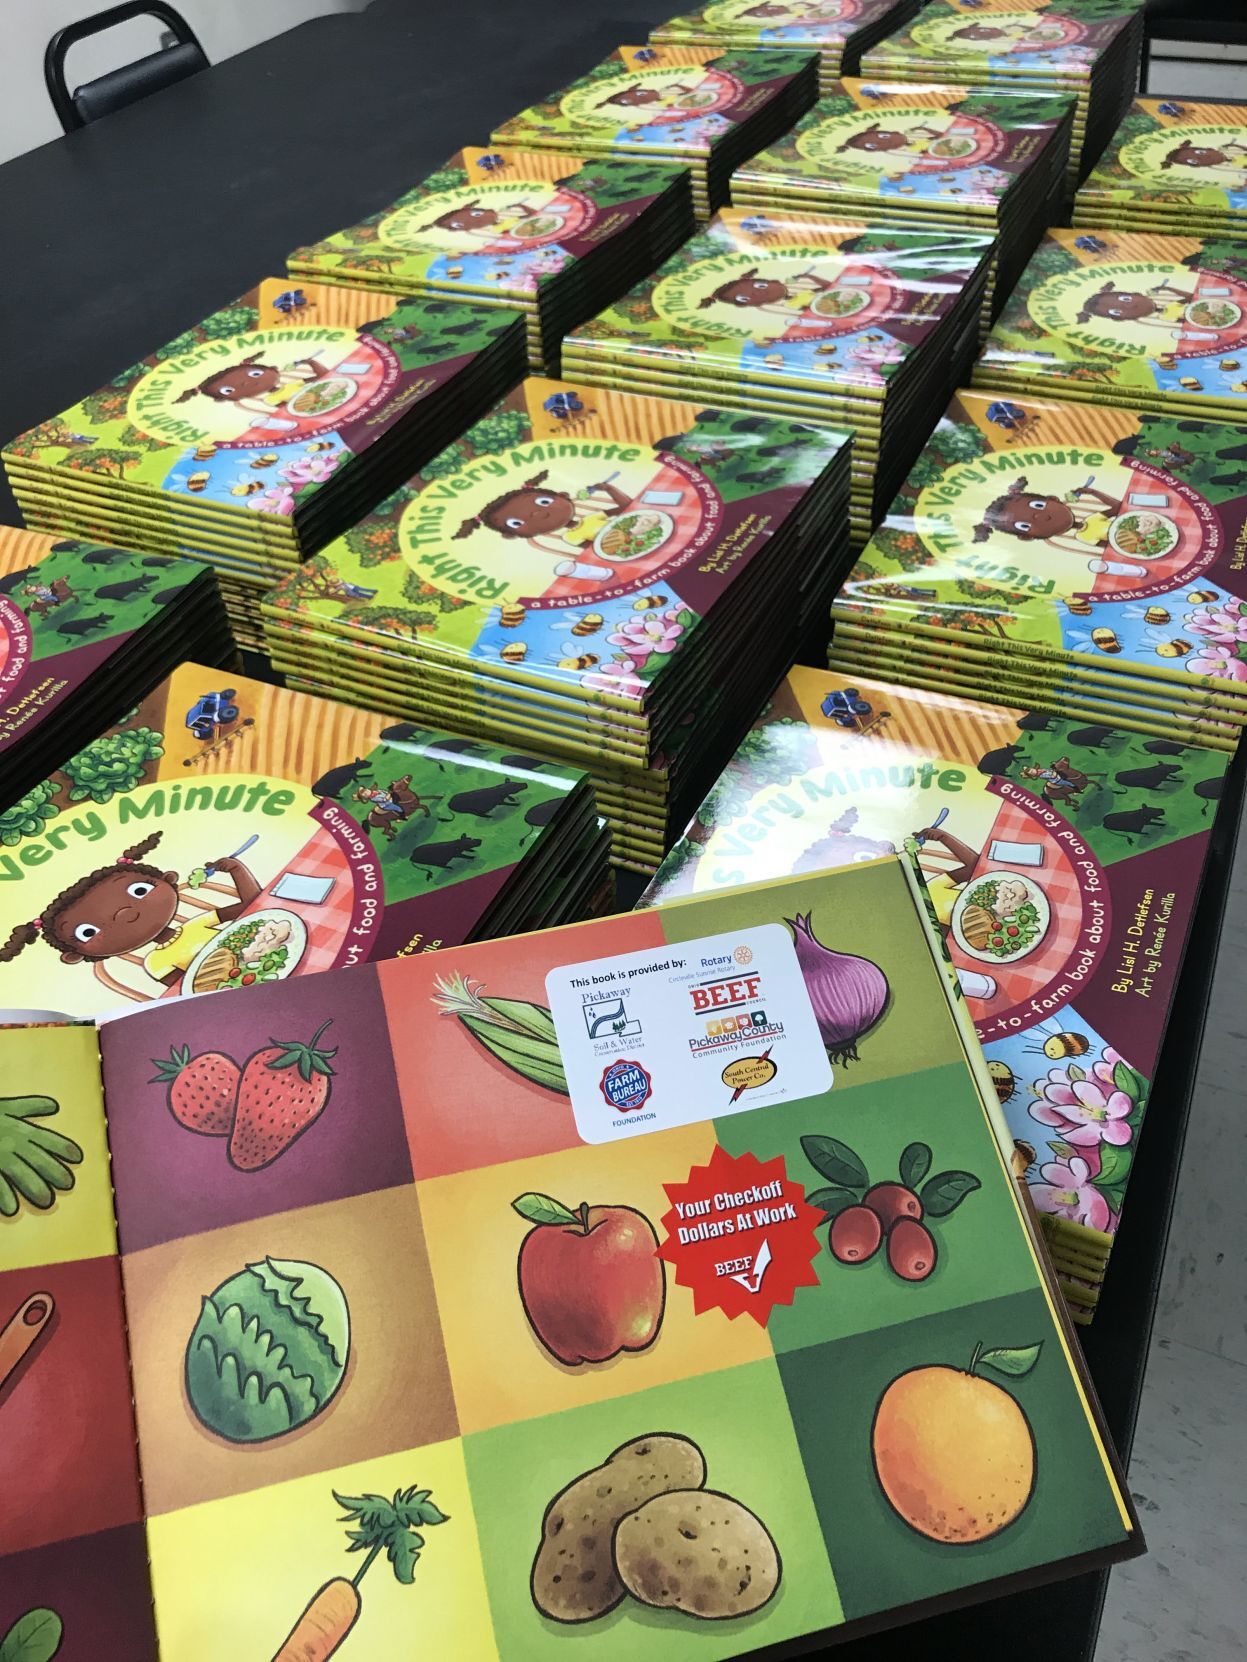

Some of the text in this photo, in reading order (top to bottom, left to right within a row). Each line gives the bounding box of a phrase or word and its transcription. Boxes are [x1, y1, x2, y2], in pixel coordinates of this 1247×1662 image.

[850, 108, 938, 123] Minute
[1158, 126, 1241, 140] Minute
[454, 182, 545, 199] Minute
[665, 262, 725, 287] Very
[1081, 262, 1175, 282] Minute
[1035, 273, 1082, 303] Very
[658, 289, 690, 315] This
[1035, 303, 1071, 331] This
[1066, 329, 1147, 357] Right
[136, 328, 346, 443] Right This Very Minute
[924, 468, 988, 506] Very
[979, 449, 1105, 474] Minute
[1130, 460, 1178, 487] farming
[699, 482, 717, 499] and
[1177, 486, 1200, 502] and
[407, 442, 641, 600] Right This Very Minute
[704, 500, 719, 519] food
[1194, 501, 1214, 522] food
[695, 521, 717, 547] about
[1205, 524, 1220, 548] about
[667, 547, 696, 568] book
[698, 562, 717, 573] By
[1195, 549, 1216, 565] book
[531, 600, 541, 608] a
[2, 657, 25, 682] food
[15, 636, 28, 655] and
[983, 637, 1075, 661] Right This Very Minute
[6, 676, 55, 716] Detlefsen
[714, 762, 967, 858] Very Minute
[1000, 783, 1062, 829] farming
[0, 781, 296, 881] Very Minute
[322, 806, 369, 860] farming
[1058, 830, 1087, 857] and
[357, 863, 378, 891] and
[1077, 860, 1103, 893] food
[352, 898, 378, 936] food
[1083, 899, 1105, 944] about
[1111, 888, 1155, 994] By Lisl H. Detlefsen
[1134, 892, 1176, 998] Art by Renée Kurilla
[569, 958, 687, 989] This book is provided by:
[700, 954, 732, 968] Rotary
[1065, 947, 1097, 981] book
[580, 986, 632, 1004] Pickaway
[689, 976, 762, 1011] BEEF
[593, 1036, 643, 1052] Soil & Water
[692, 1033, 787, 1059] Community Foundation
[607, 1069, 640, 1092] FARM
[724, 1062, 769, 1079] South Central
[731, 1072, 766, 1085] Power Co.
[612, 1078, 646, 1102] BUREAU
[612, 1112, 657, 1127] FOUNDATION
[675, 1180, 784, 1220] Your Checkoff
[677, 1202, 797, 1246] Dollars At Work
[714, 1255, 753, 1277] BEEF
